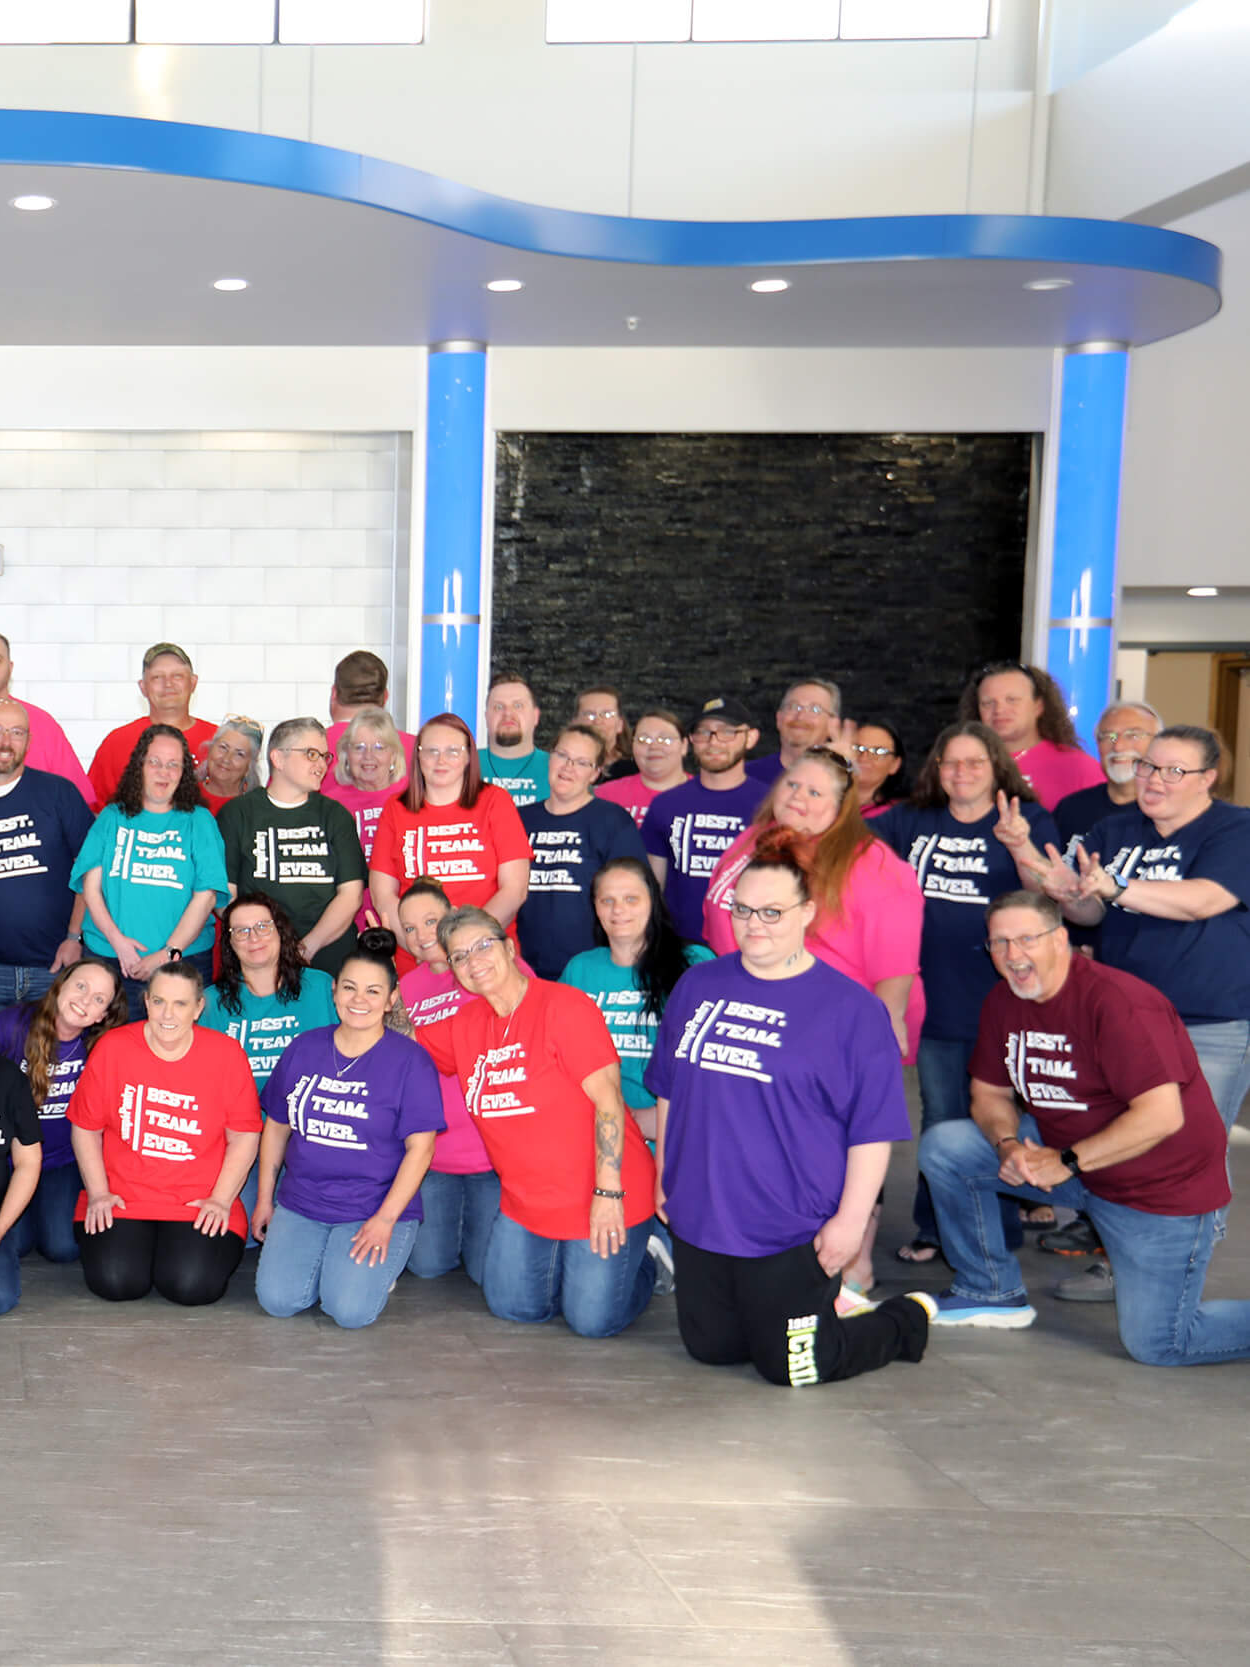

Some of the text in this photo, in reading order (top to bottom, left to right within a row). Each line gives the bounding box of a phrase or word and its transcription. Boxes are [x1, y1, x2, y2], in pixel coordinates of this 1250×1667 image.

[426, 822, 478, 837] BEST.
[693, 814, 746, 831] BEST.
[136, 829, 182, 844] BEST.
[277, 826, 325, 840] BEST.
[535, 831, 583, 845] BEST.
[135, 845, 187, 861] TEAM.
[278, 843, 328, 856] TEAM
[427, 838, 485, 853] TEAM.
[131, 862, 178, 881] EVER.
[278, 862, 326, 876] EVER.
[427, 859, 478, 875] EVER.
[931, 852, 989, 874] TEAM.
[925, 873, 980, 895] EVER.
[418, 990, 460, 1011] BEST.
[250, 1015, 300, 1032] BEST.
[413, 1006, 459, 1027] TEAM
[723, 1001, 787, 1027] BEST.
[715, 1021, 782, 1048] TEAM.
[487, 1042, 526, 1063] BEST.
[701, 1042, 763, 1070] EVER.
[486, 1066, 527, 1086] TEAM.
[316, 1076, 369, 1097] BEST.
[145, 1087, 199, 1111] BEST.
[311, 1095, 369, 1119] TEAM.
[480, 1091, 522, 1110] EVER.
[144, 1109, 202, 1135] TEAM.
[306, 1118, 358, 1141] EVER.
[141, 1131, 193, 1154] EVER.
